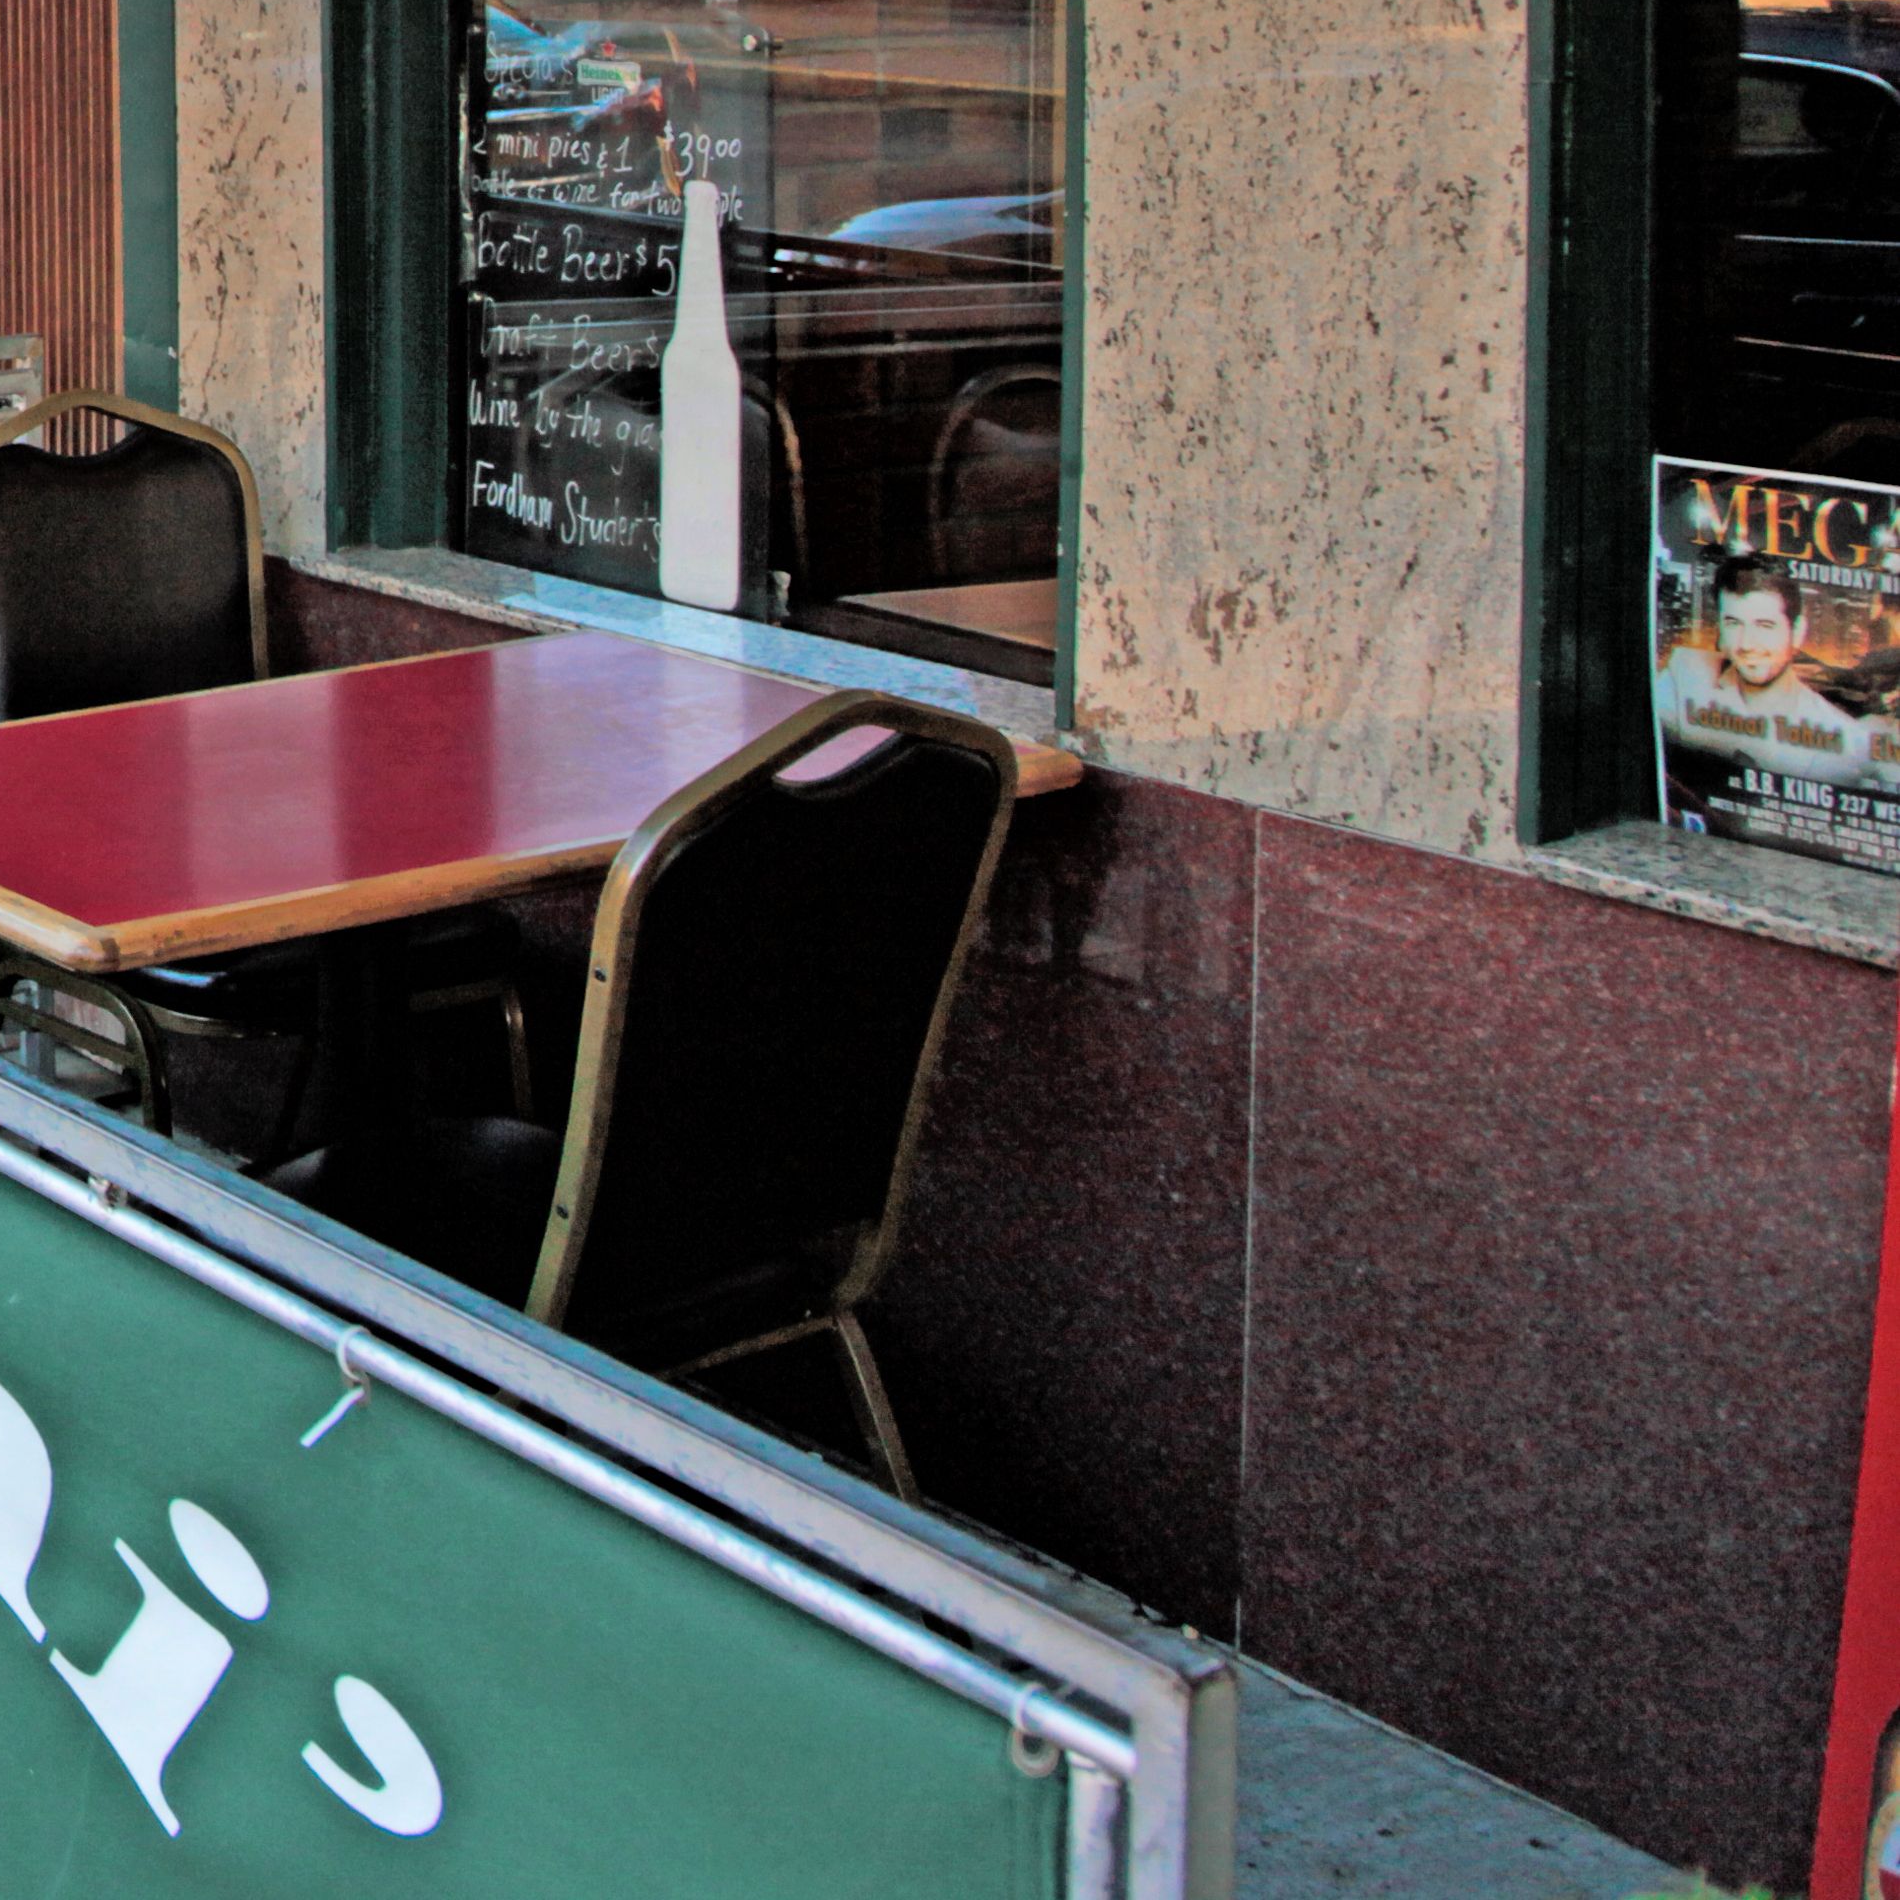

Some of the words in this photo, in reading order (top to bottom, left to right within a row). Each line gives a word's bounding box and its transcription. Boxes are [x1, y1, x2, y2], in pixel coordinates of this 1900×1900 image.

[496, 130, 541, 159] mini
[548, 135, 592, 169] pies
[560, 223, 628, 283] Beer
[472, 460, 553, 530] Fordham
[1787, 559, 1874, 592] SATURDAY
[1783, 775, 1834, 809] KING
